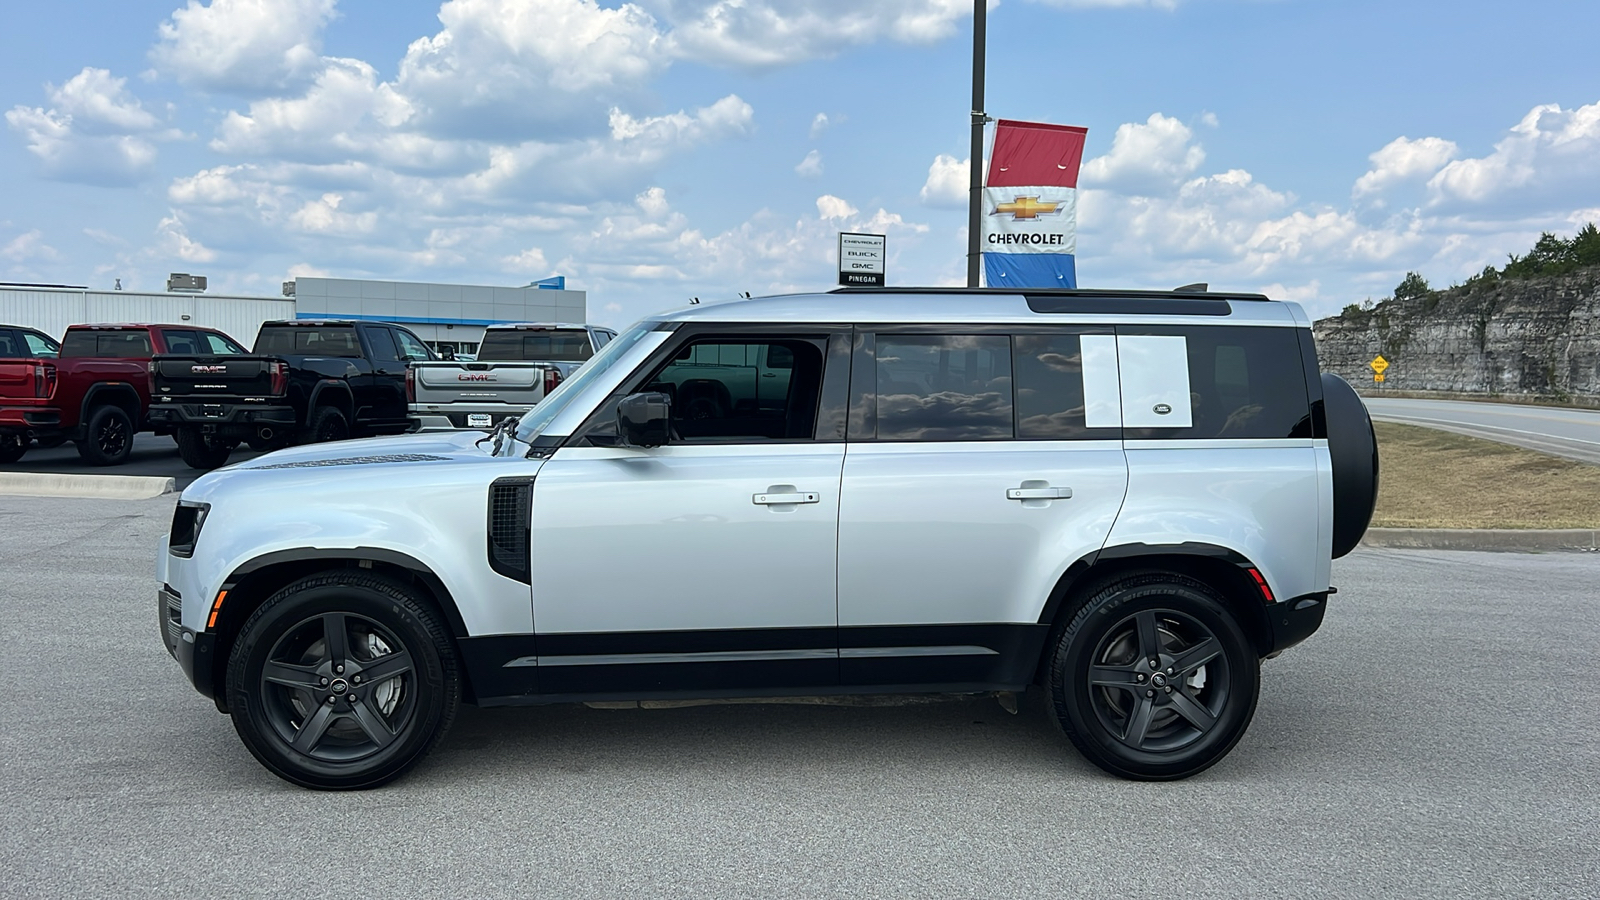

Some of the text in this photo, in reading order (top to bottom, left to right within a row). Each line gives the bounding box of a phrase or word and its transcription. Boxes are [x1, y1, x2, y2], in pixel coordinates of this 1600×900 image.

[988, 233, 1064, 245] CHEVROLET
[848, 275, 877, 283] PINEGAR
[192, 365, 226, 373] GMC
[458, 374, 497, 382] GMC
